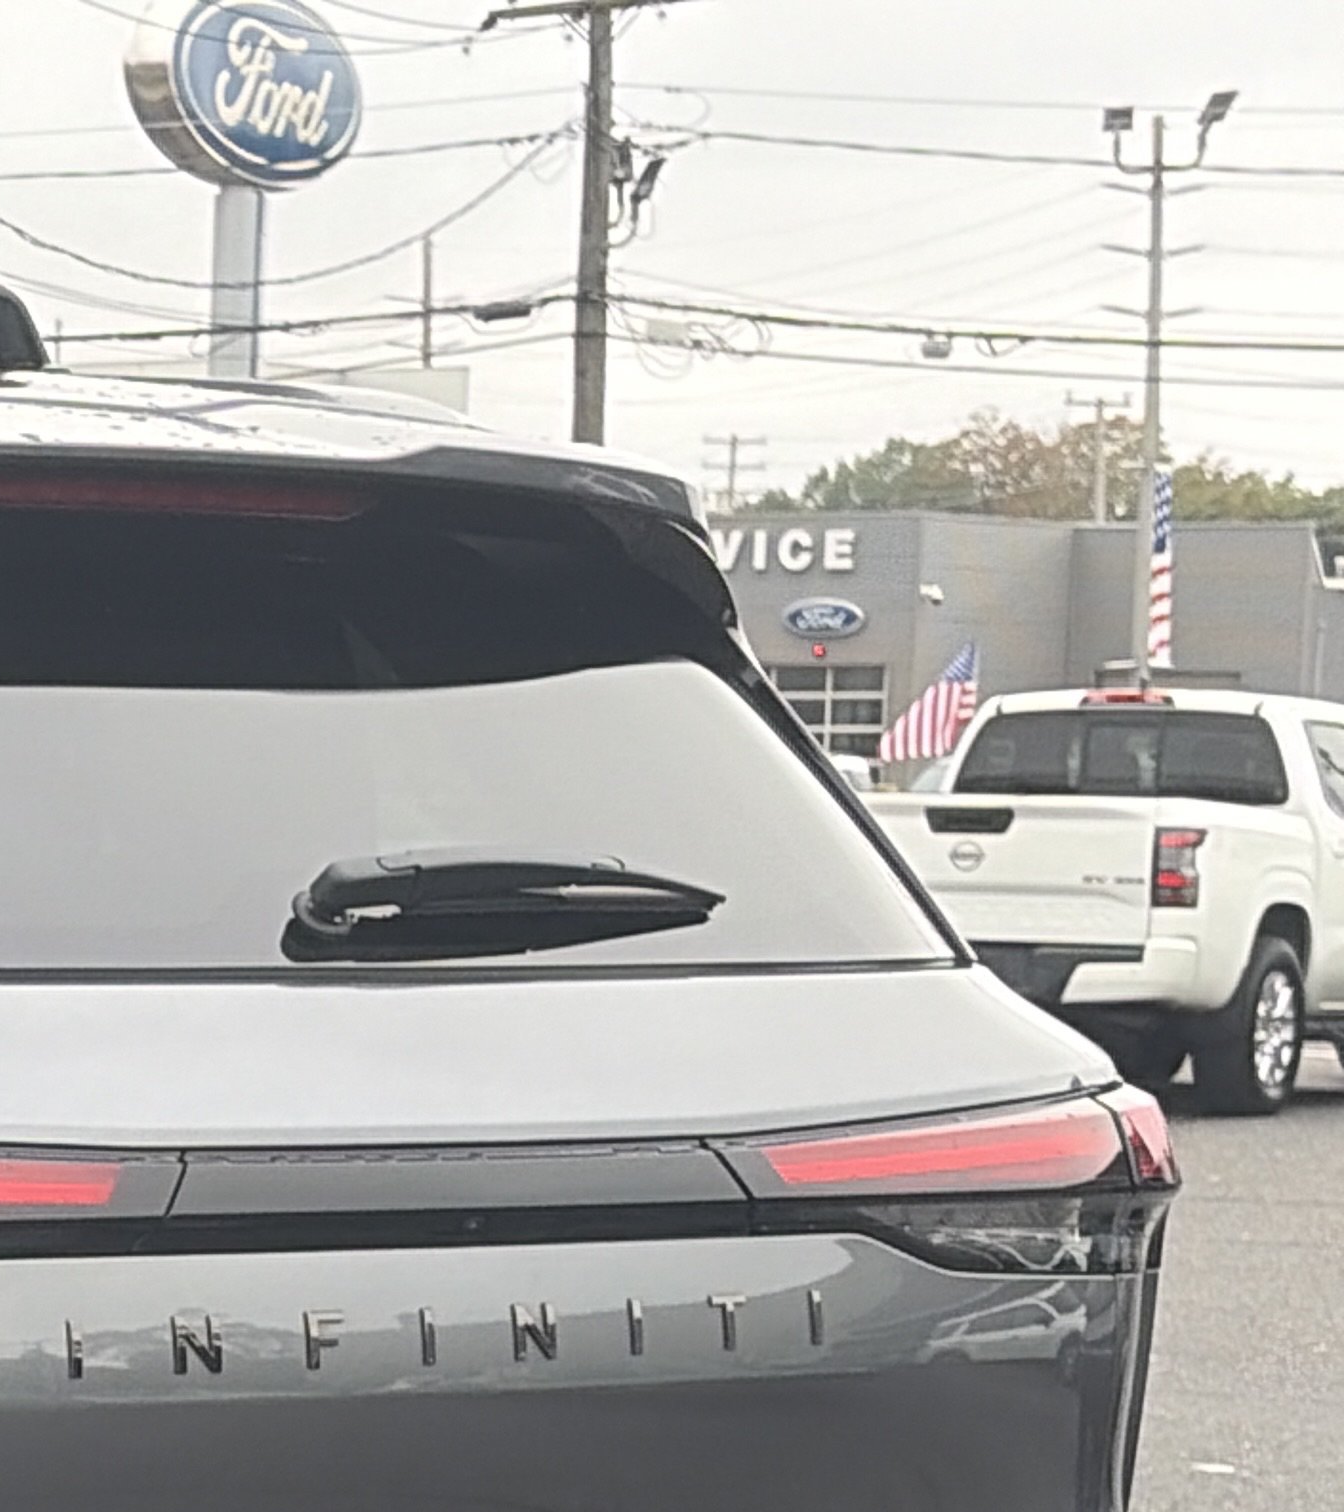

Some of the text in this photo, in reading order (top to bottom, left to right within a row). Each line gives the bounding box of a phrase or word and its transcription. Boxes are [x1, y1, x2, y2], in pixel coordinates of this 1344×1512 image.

[215, 17, 333, 146] Ford
[710, 528, 855, 572] VICE
[66, 1289, 825, 1378] INFINITI
